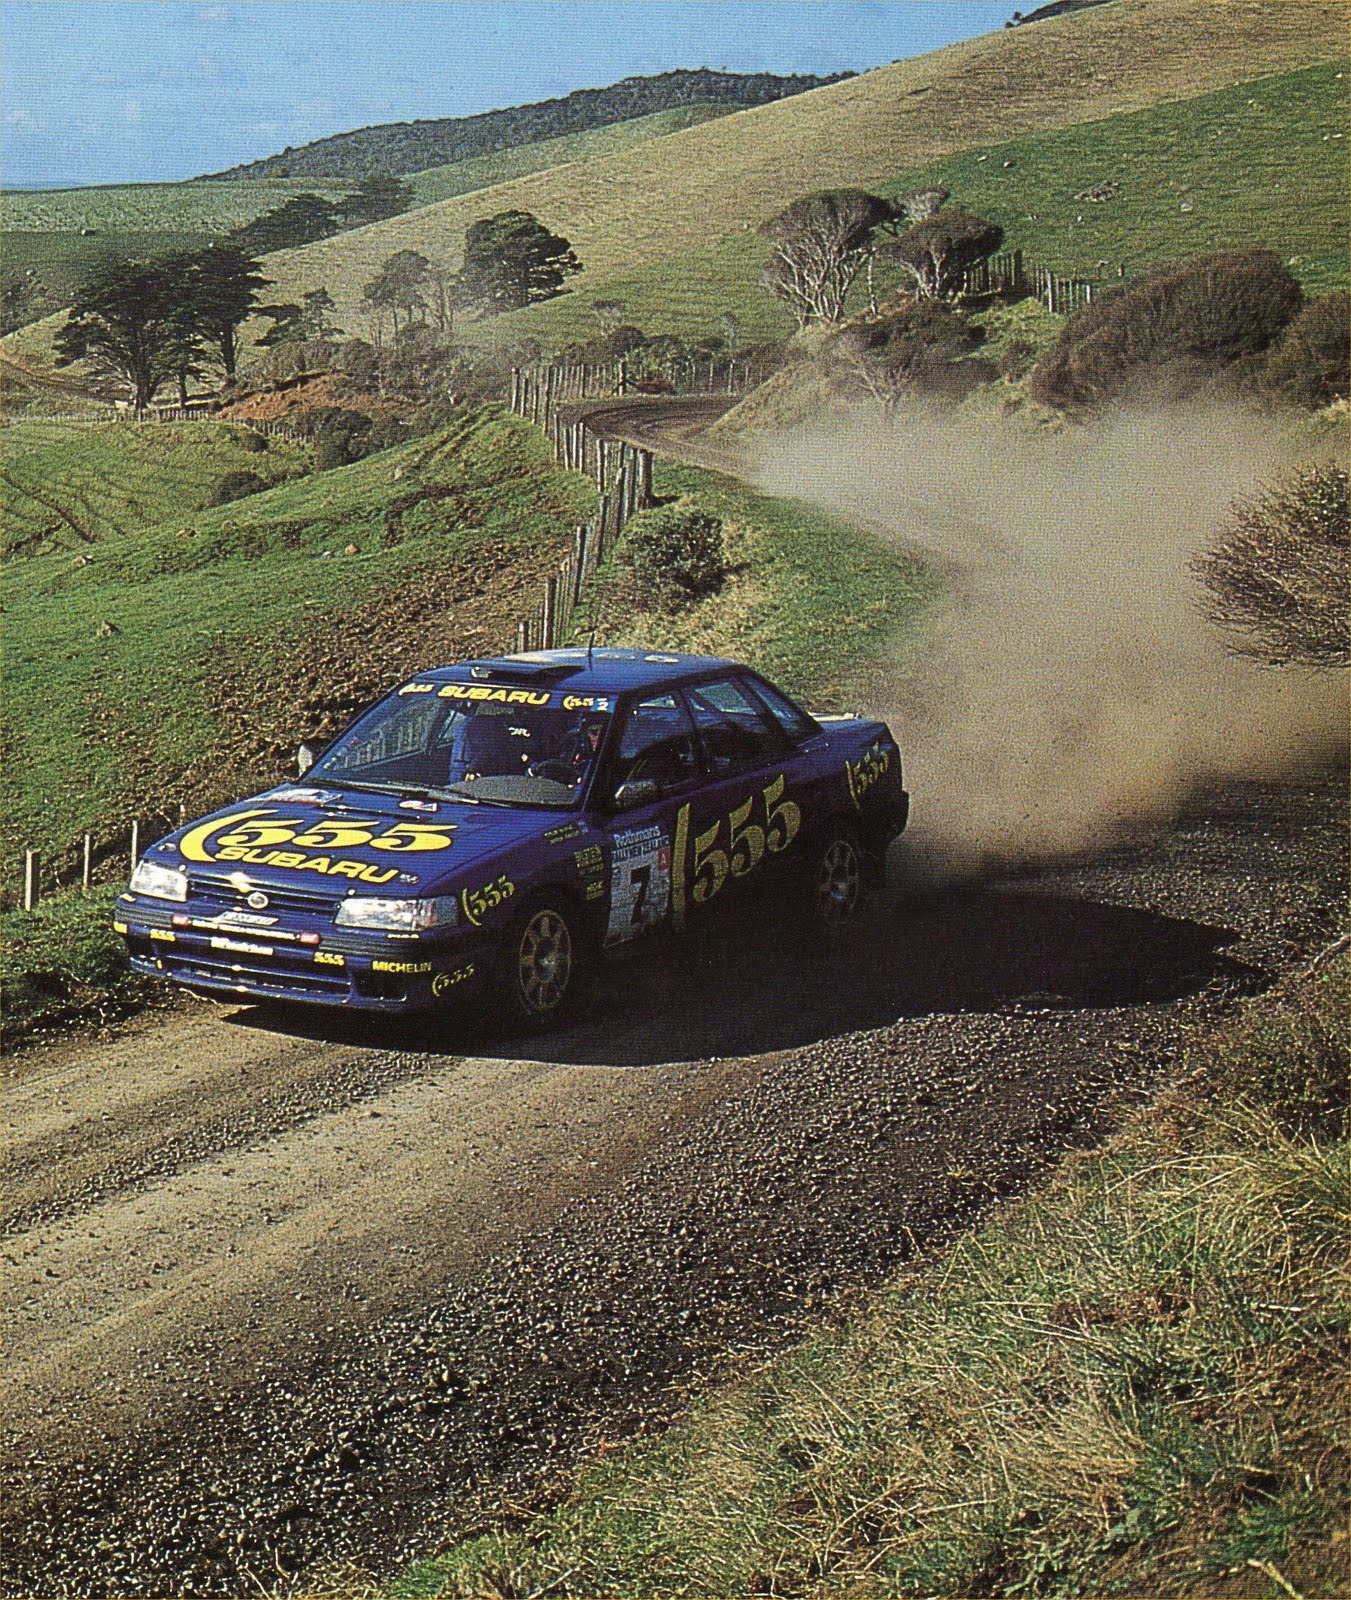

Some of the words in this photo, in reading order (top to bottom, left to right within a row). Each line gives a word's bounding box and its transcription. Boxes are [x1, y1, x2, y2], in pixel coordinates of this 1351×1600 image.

[438, 685, 550, 705] SUBARU
[854, 742, 890, 796] 555
[217, 820, 458, 851] 555
[612, 826, 661, 848] Rothmans
[693, 773, 800, 902] 555
[215, 846, 399, 884] SUBARU
[468, 875, 515, 916] 555
[630, 864, 651, 926] 7
[313, 951, 345, 966] 555
[372, 960, 433, 974] MICHELIN
